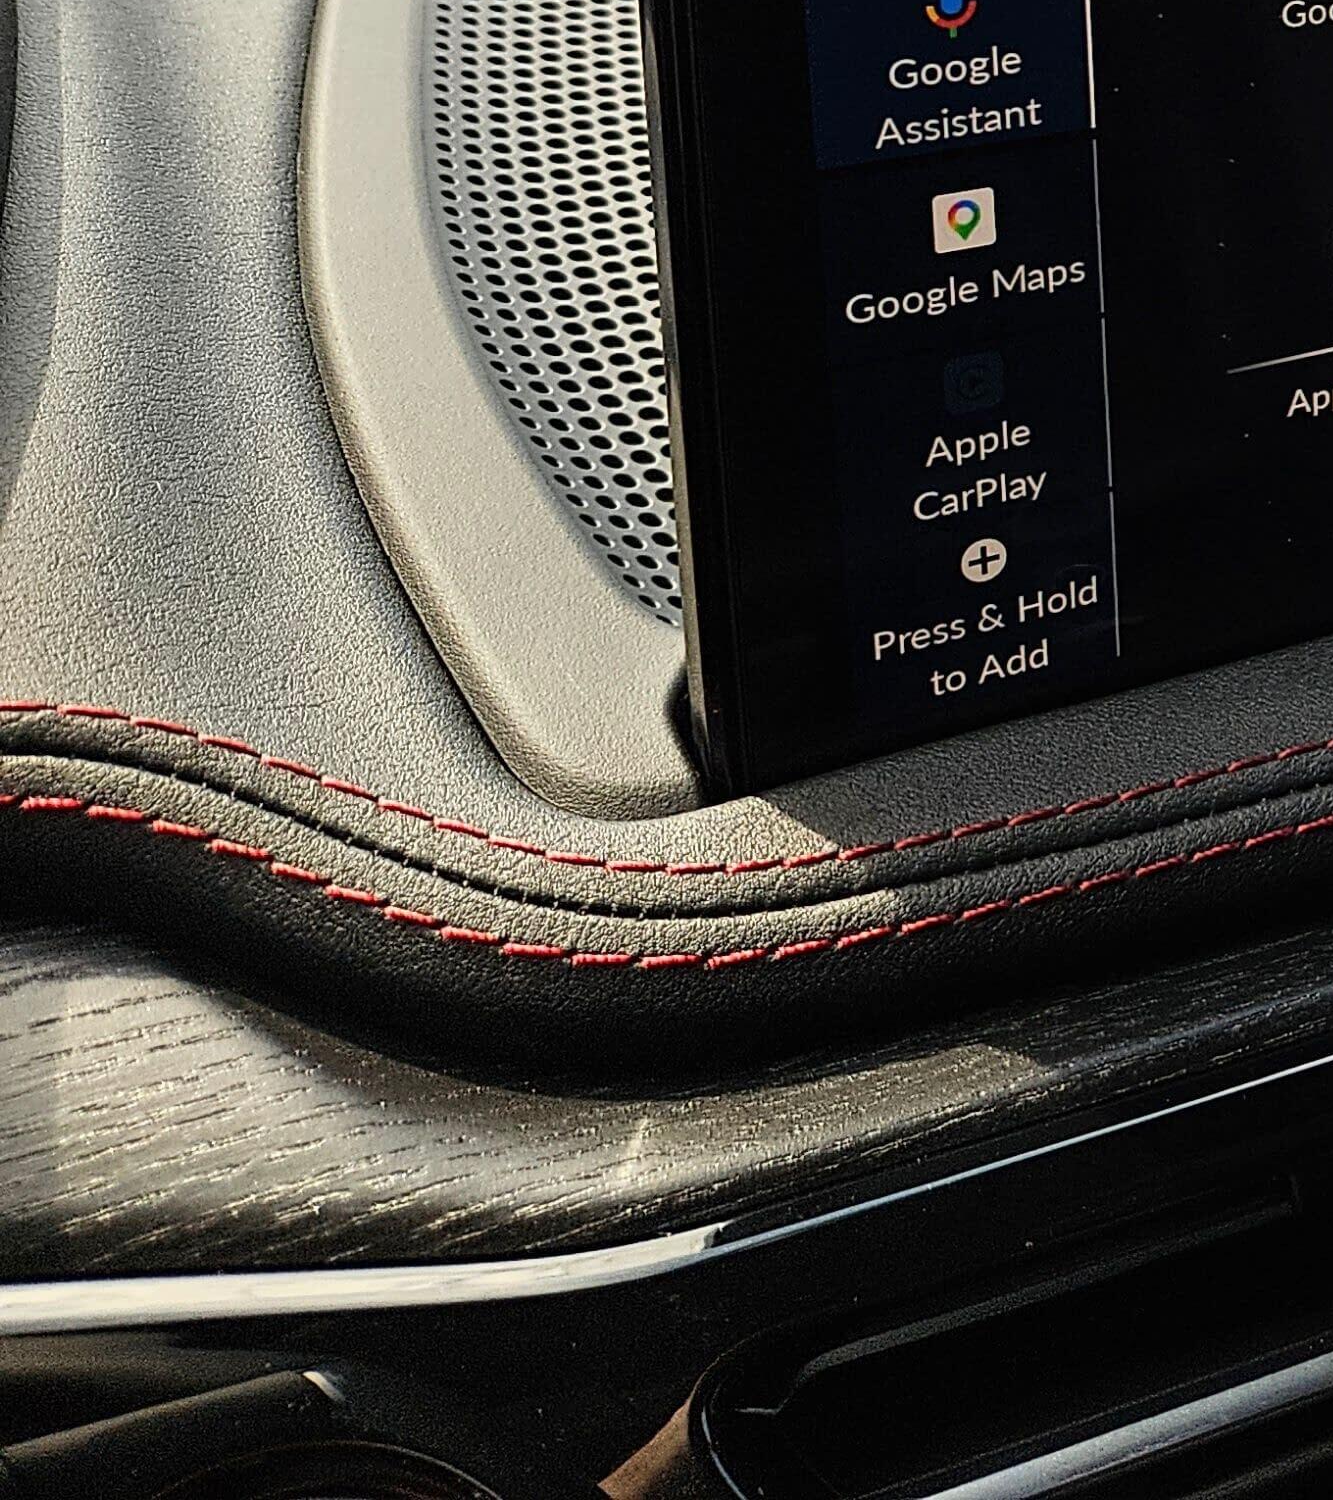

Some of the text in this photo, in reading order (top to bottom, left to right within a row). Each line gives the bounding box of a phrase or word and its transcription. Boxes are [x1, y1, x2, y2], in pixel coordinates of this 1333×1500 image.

[888, 45, 1022, 89] Google
[875, 98, 1043, 150] Assistant
[845, 261, 1086, 324] Google Maps
[925, 420, 1031, 468] Apple
[913, 471, 1047, 521] CarPlay
[873, 575, 1098, 661] Press & Hold
[930, 638, 1049, 696] to Add
